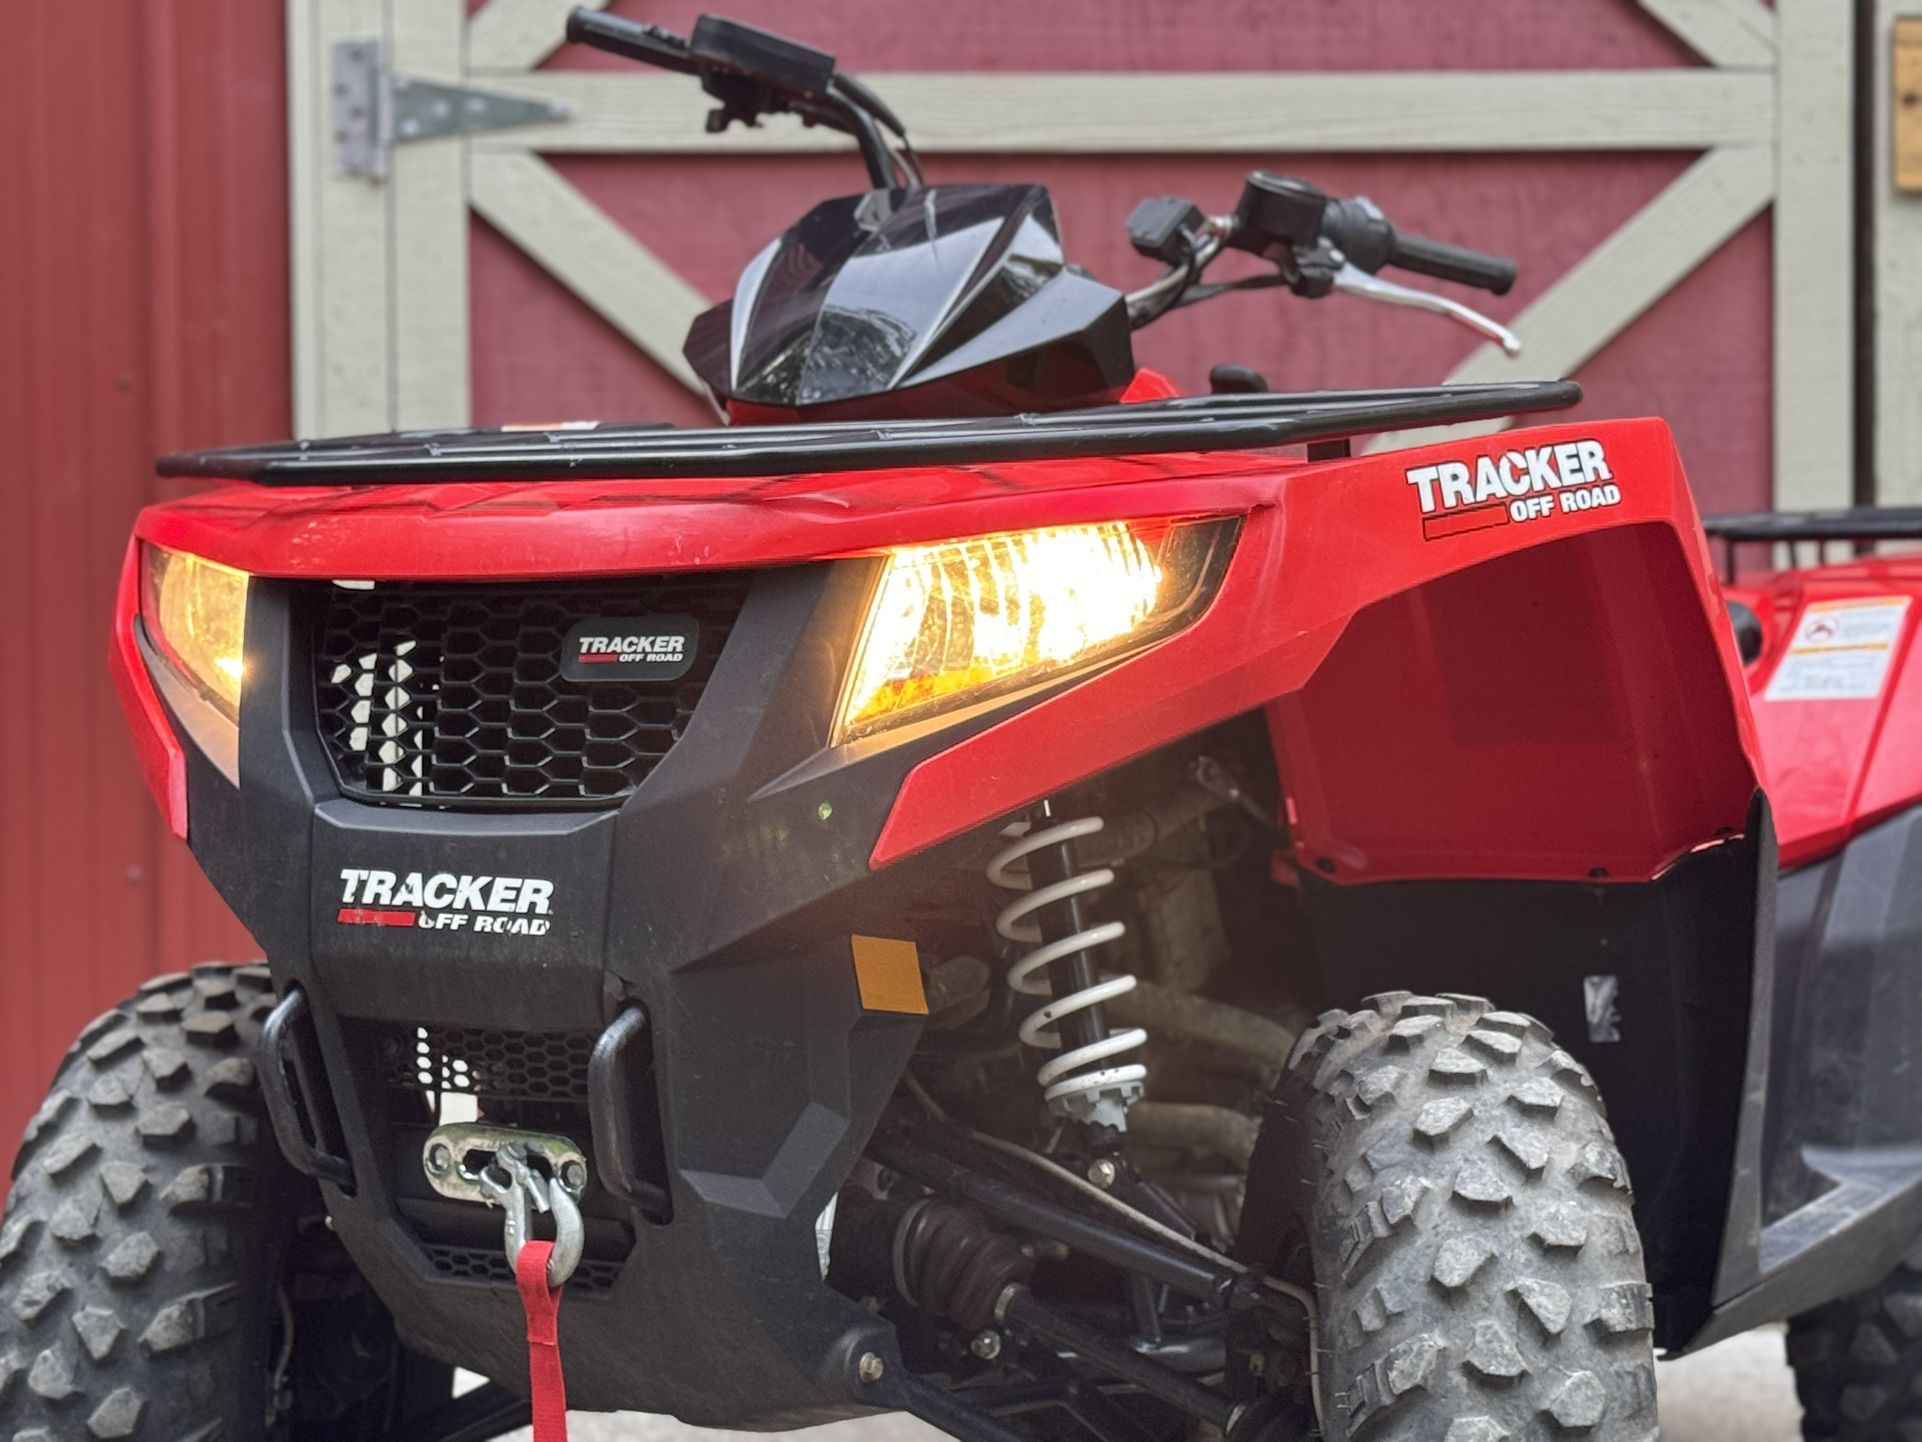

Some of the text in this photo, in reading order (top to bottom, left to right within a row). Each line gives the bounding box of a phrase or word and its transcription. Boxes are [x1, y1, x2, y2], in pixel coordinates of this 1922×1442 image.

[1406, 440, 1613, 513] TRACKER
[1510, 484, 1621, 522] OFF ROAD
[579, 636, 685, 653] TRACKER
[619, 653, 683, 662] OFF ROAD
[340, 868, 554, 914] TRACKER
[418, 910, 550, 935] OFF ROAD
